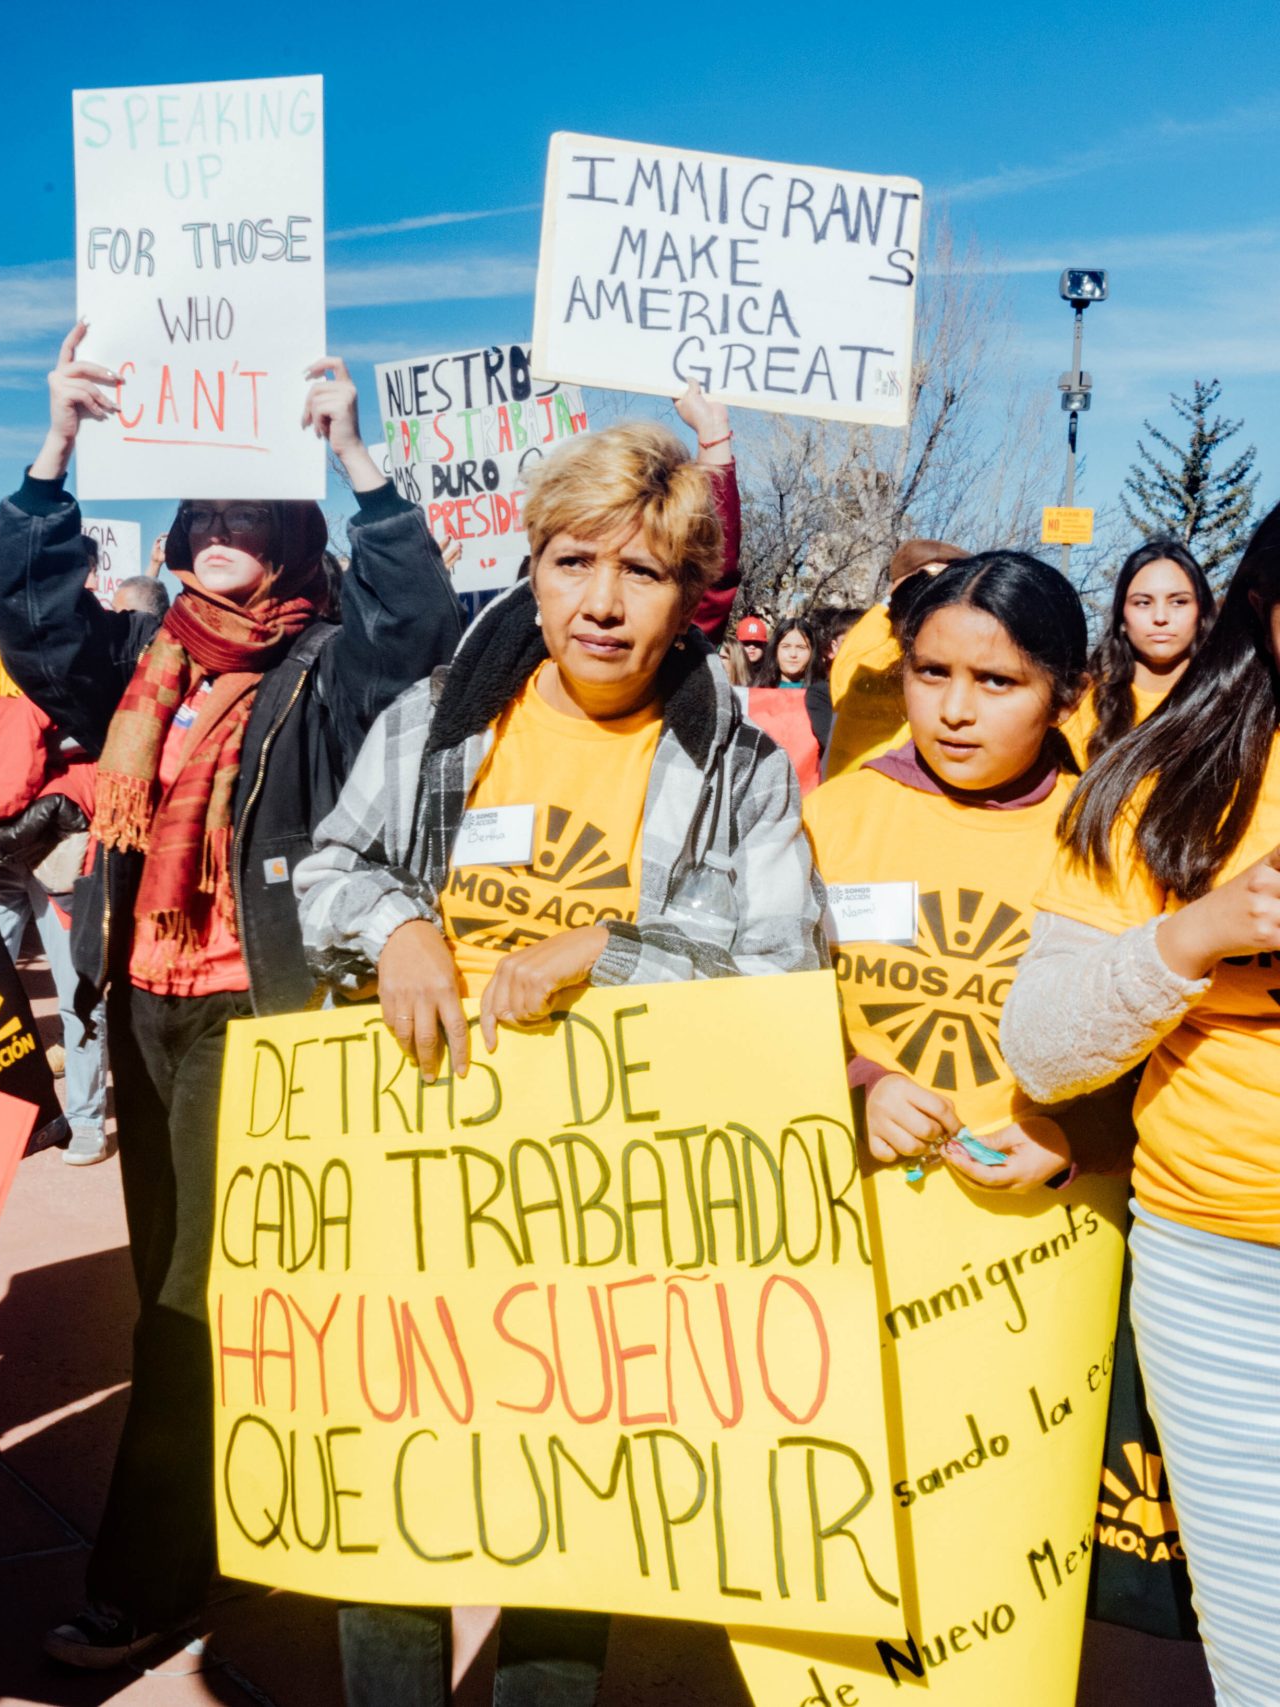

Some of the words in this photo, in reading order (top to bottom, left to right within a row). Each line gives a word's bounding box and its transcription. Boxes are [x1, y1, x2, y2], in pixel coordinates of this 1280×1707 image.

[80, 88, 317, 149] SPEAKING
[164, 153, 223, 200] UP
[88, 226, 155, 277] FOR
[182, 215, 312, 269] THOSE
[609, 225, 762, 287] MAKE
[158, 297, 234, 344] WHO
[564, 275, 801, 338] AMERICA
[117, 360, 269, 438] CAN'T
[673, 336, 894, 402] GREAT
[432, 459, 500, 498] DURO
[1048, 519, 1060, 531] NO
[552, 1003, 662, 1128] DE
[220, 1157, 354, 1272] CADA
[384, 1113, 874, 1274] TRABAJADOR
[884, 1203, 1100, 1334] mmigrants
[217, 1287, 344, 1418] HAY
[355, 1291, 475, 1426] UN
[493, 1272, 832, 1429] SUEÑO
[891, 1413, 1012, 1509] sando
[1028, 1386, 1075, 1436] la
[224, 1411, 380, 1555] QUE
[392, 1427, 900, 1608] CUMPLIR
[875, 1603, 1016, 1688] Nuevo
